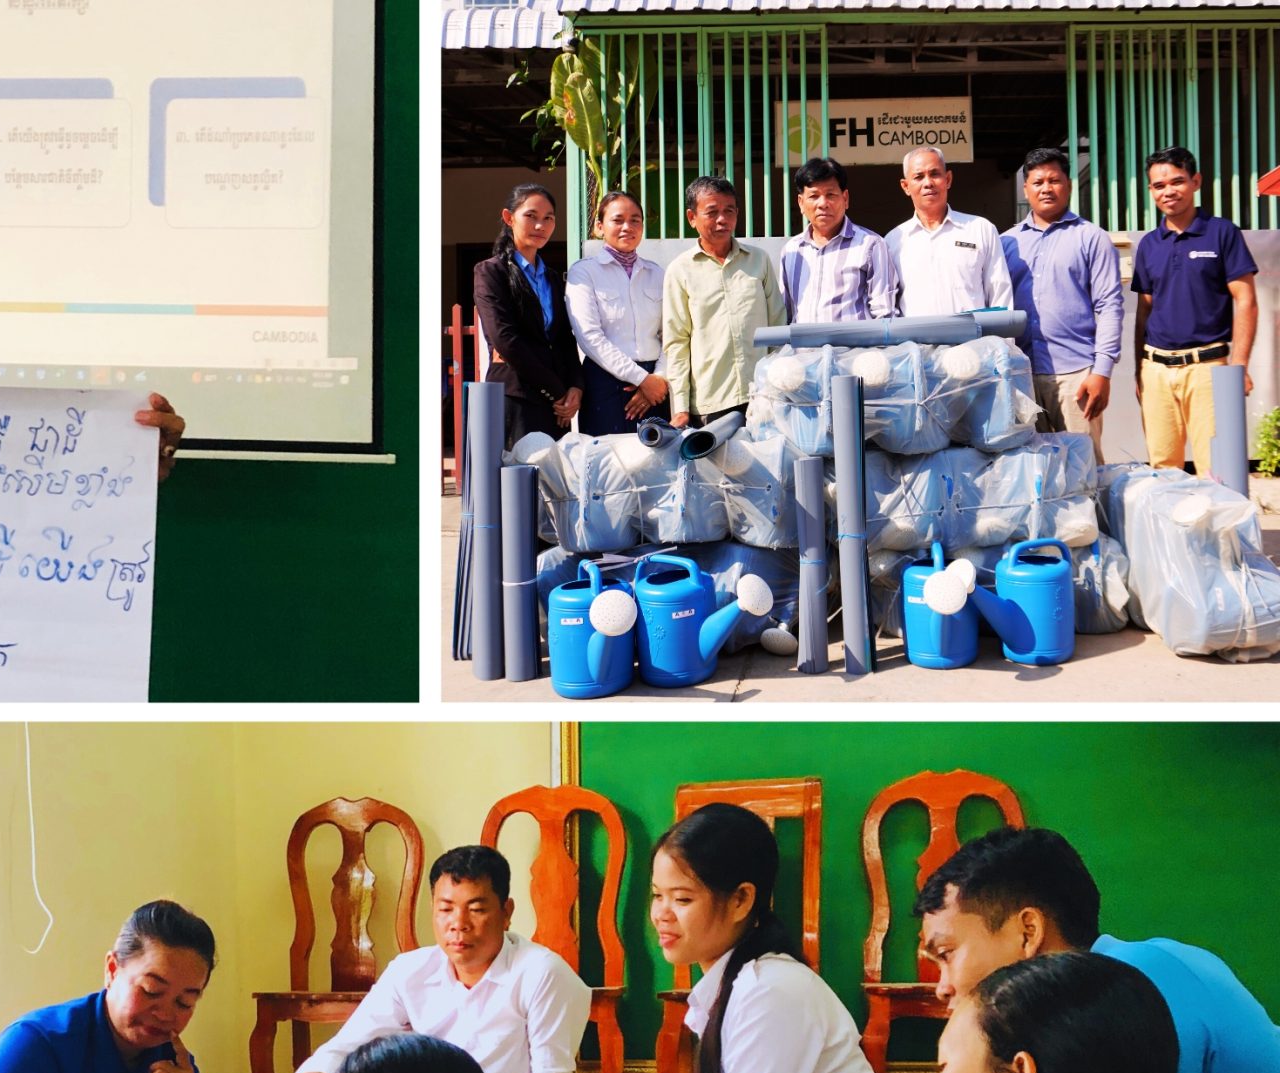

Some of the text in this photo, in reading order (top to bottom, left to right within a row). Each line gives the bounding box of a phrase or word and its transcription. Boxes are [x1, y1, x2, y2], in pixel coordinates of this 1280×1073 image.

[828, 116, 875, 148] FH
[877, 130, 968, 146] CAMBODIA
[252, 330, 319, 344] CAMBODIA
